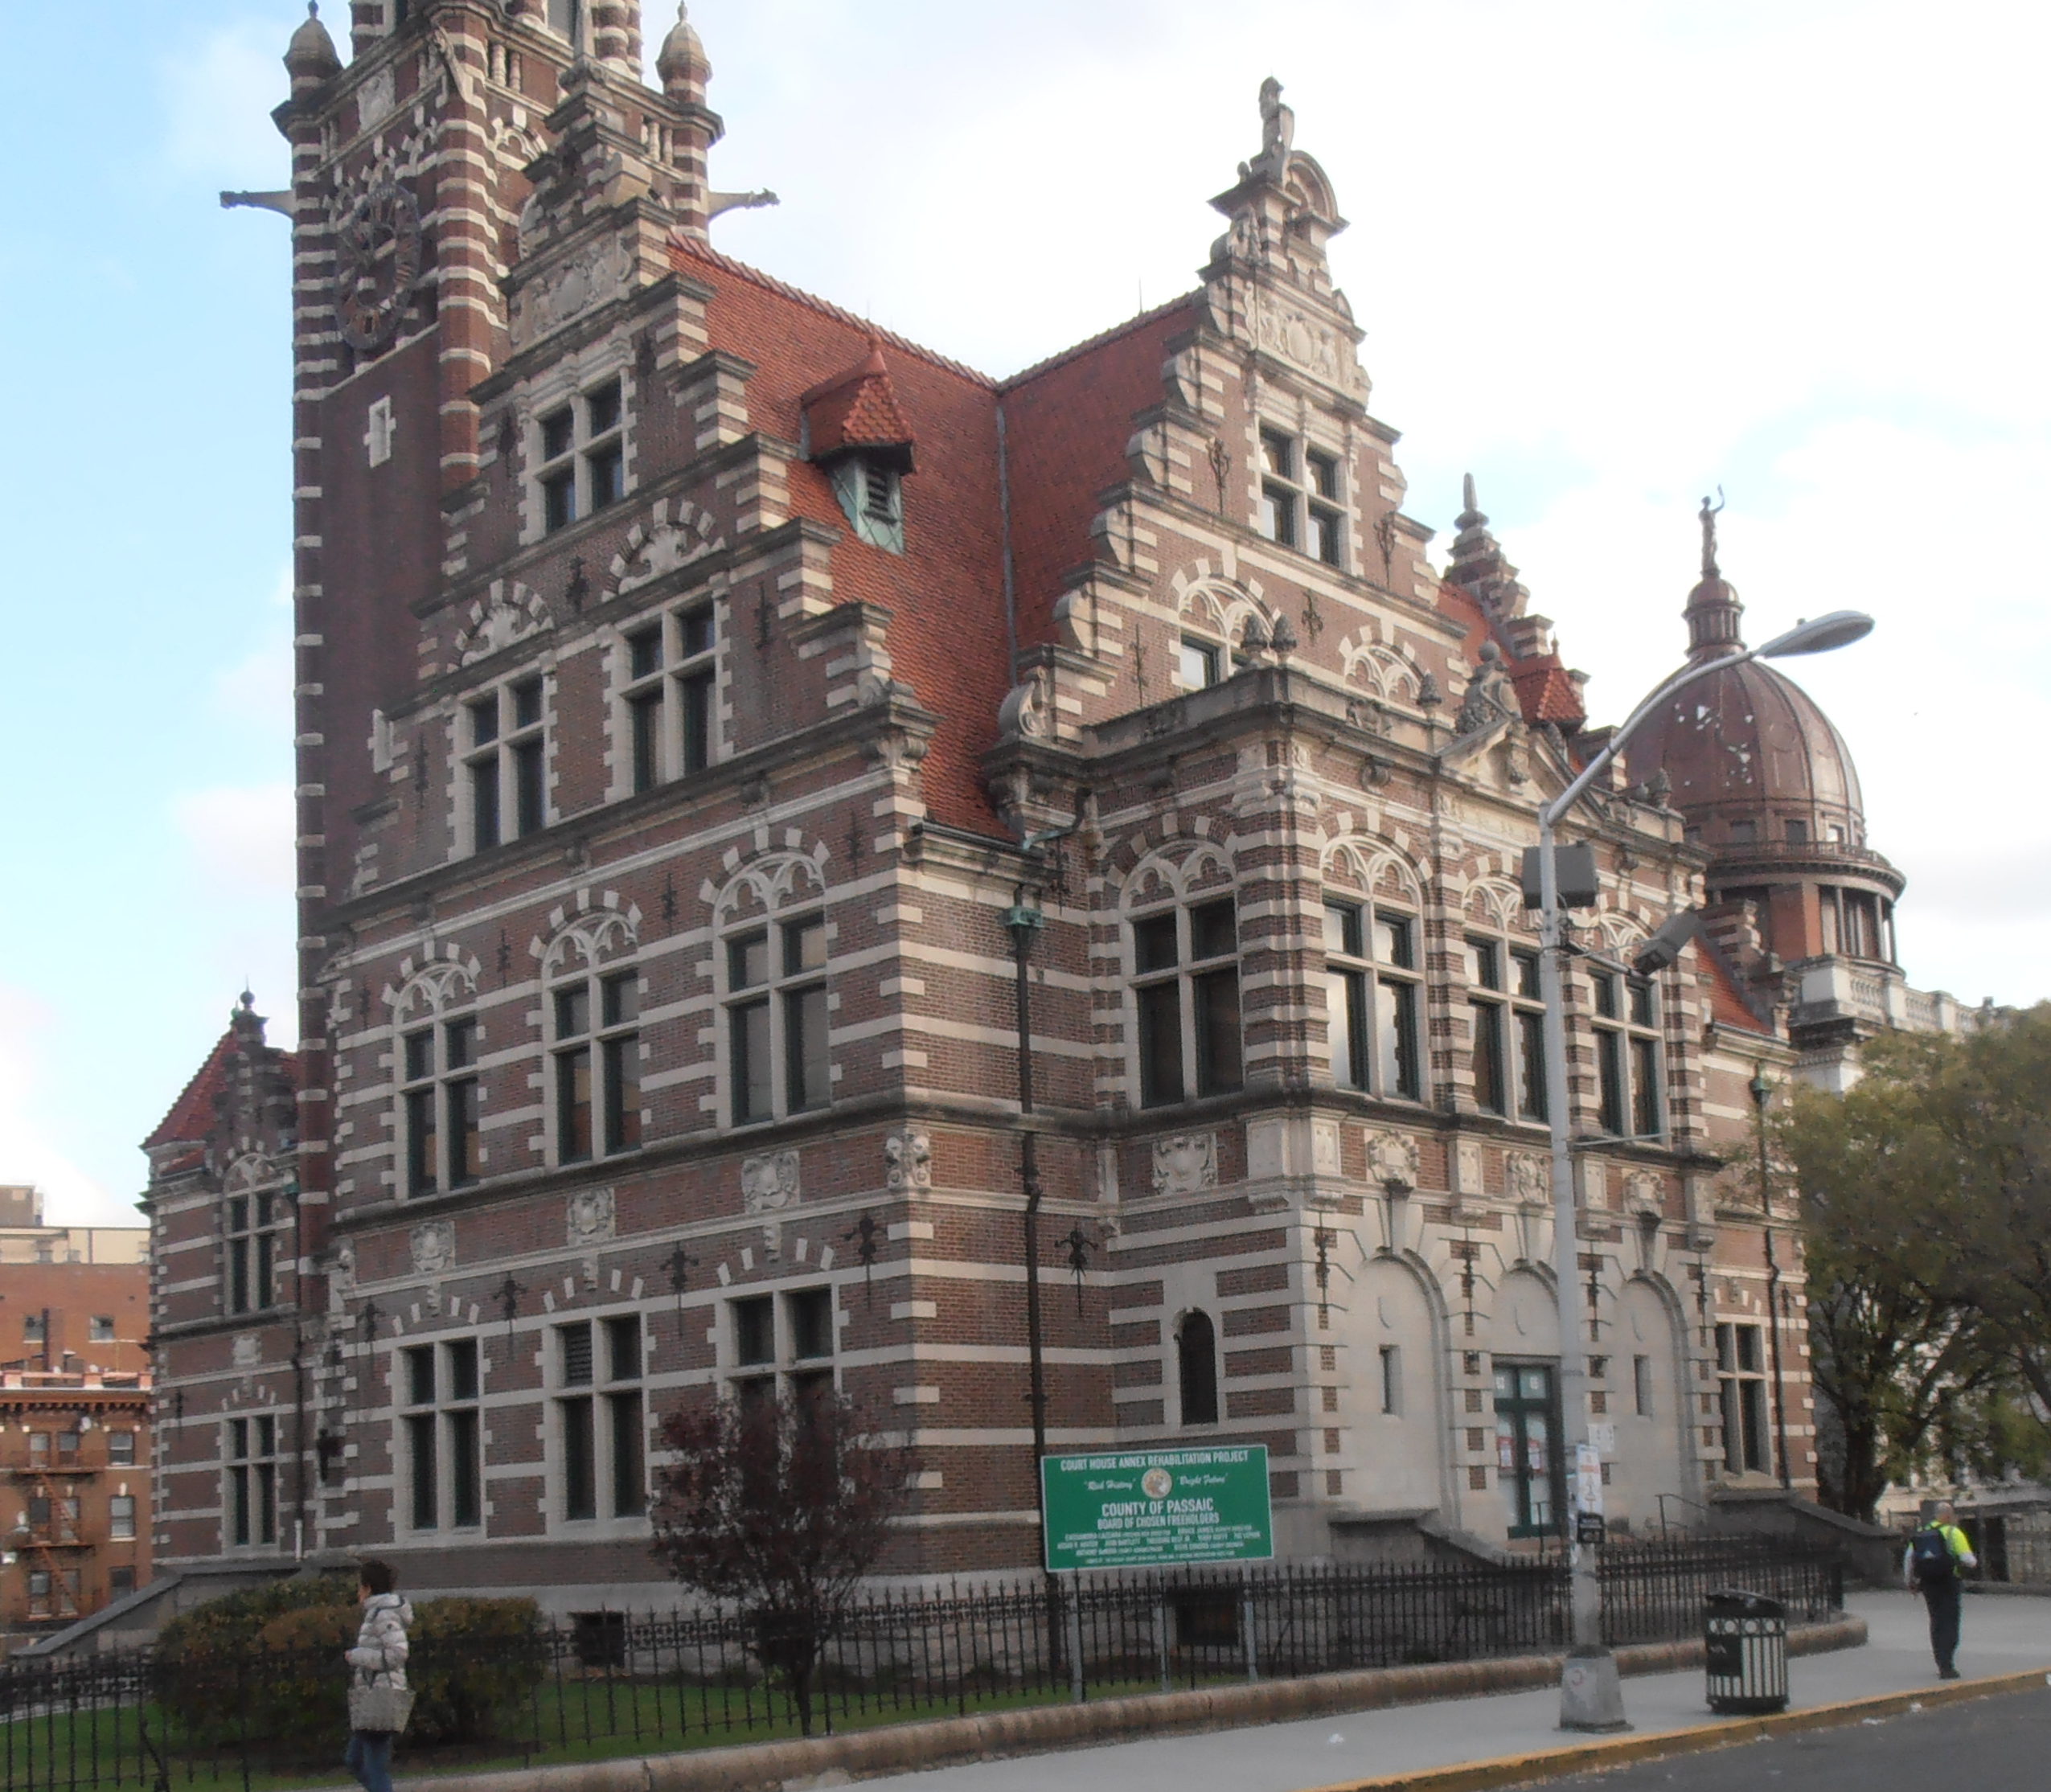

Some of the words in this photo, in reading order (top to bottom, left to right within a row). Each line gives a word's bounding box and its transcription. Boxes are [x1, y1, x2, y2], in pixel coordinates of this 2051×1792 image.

[1060, 1458, 1087, 1471] COURT
[1089, 1457, 1117, 1470] HOUSE
[1118, 1455, 1147, 1468] ANNEX
[1148, 1451, 1212, 1466] REHABILITATION
[1213, 1449, 1249, 1463] PROJECT
[1101, 1501, 1146, 1517] COUNTY
[1149, 1500, 1164, 1515] OF
[1167, 1497, 1214, 1513] PASSAIC
[1097, 1518, 1123, 1530] BOARD
[1125, 1516, 1134, 1528] OF
[1136, 1515, 1166, 1528] CHOSEN
[1167, 1512, 1220, 1526] FREEHOLDERS
